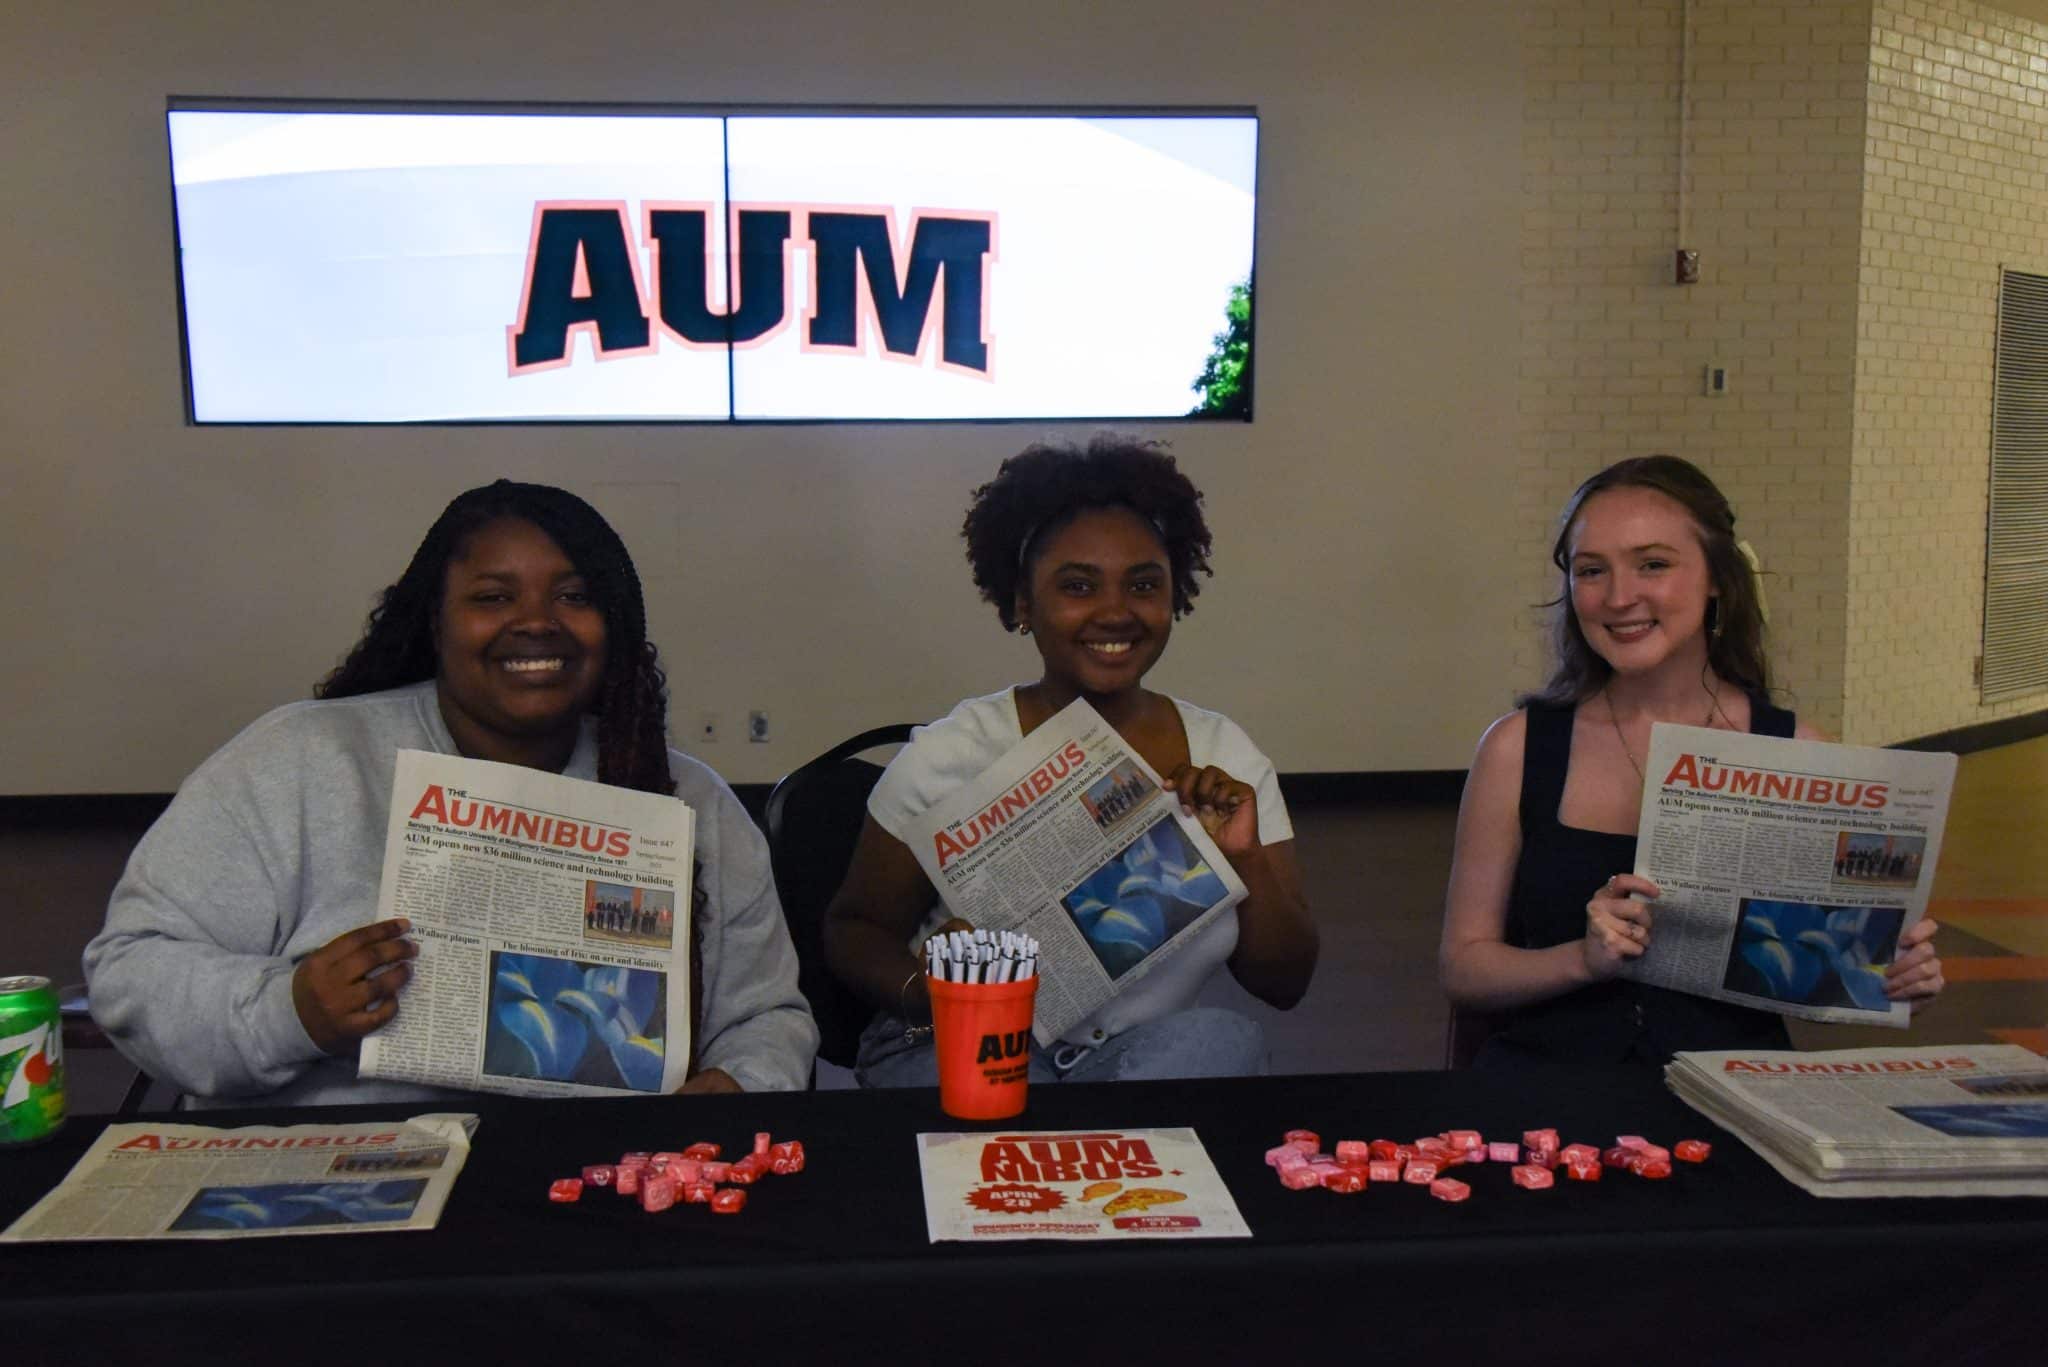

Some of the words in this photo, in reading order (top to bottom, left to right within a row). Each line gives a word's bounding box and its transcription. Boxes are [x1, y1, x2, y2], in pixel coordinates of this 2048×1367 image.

[506, 199, 999, 384] AUM
[1699, 756, 1718, 765] THE
[1663, 753, 1889, 809] AUMNIBUS
[447, 787, 468, 798] THE
[934, 742, 1086, 868] AUMNIBUS
[1658, 797, 1683, 808] AUM
[1685, 801, 1712, 812] opens
[1713, 806, 1731, 814] new
[1733, 807, 1750, 817] $36
[1751, 809, 1784, 820] million
[1785, 813, 1818, 824] science
[1820, 816, 1838, 826] and
[1839, 819, 1887, 832] technology
[409, 783, 632, 858] AUMNIBUS
[946, 820, 962, 832] THE
[404, 833, 430, 846] AUM
[432, 838, 461, 850] opens
[463, 843, 481, 853] new
[483, 846, 500, 857] $36
[501, 850, 532, 864] million
[534, 857, 565, 871] science
[566, 862, 584, 873] and
[585, 865, 634, 881] technology
[636, 873, 674, 888] building
[418, 928, 448, 940] Wallace
[450, 934, 480, 945] plaques
[503, 941, 518, 949] The
[520, 943, 558, 957] blooming
[1723, 1057, 1978, 1074] AUMNIBUS
[115, 1133, 400, 1152] AUMNIBUS
[981, 1139, 1157, 1166] AUM
[990, 1191, 1042, 1200] APRIL
